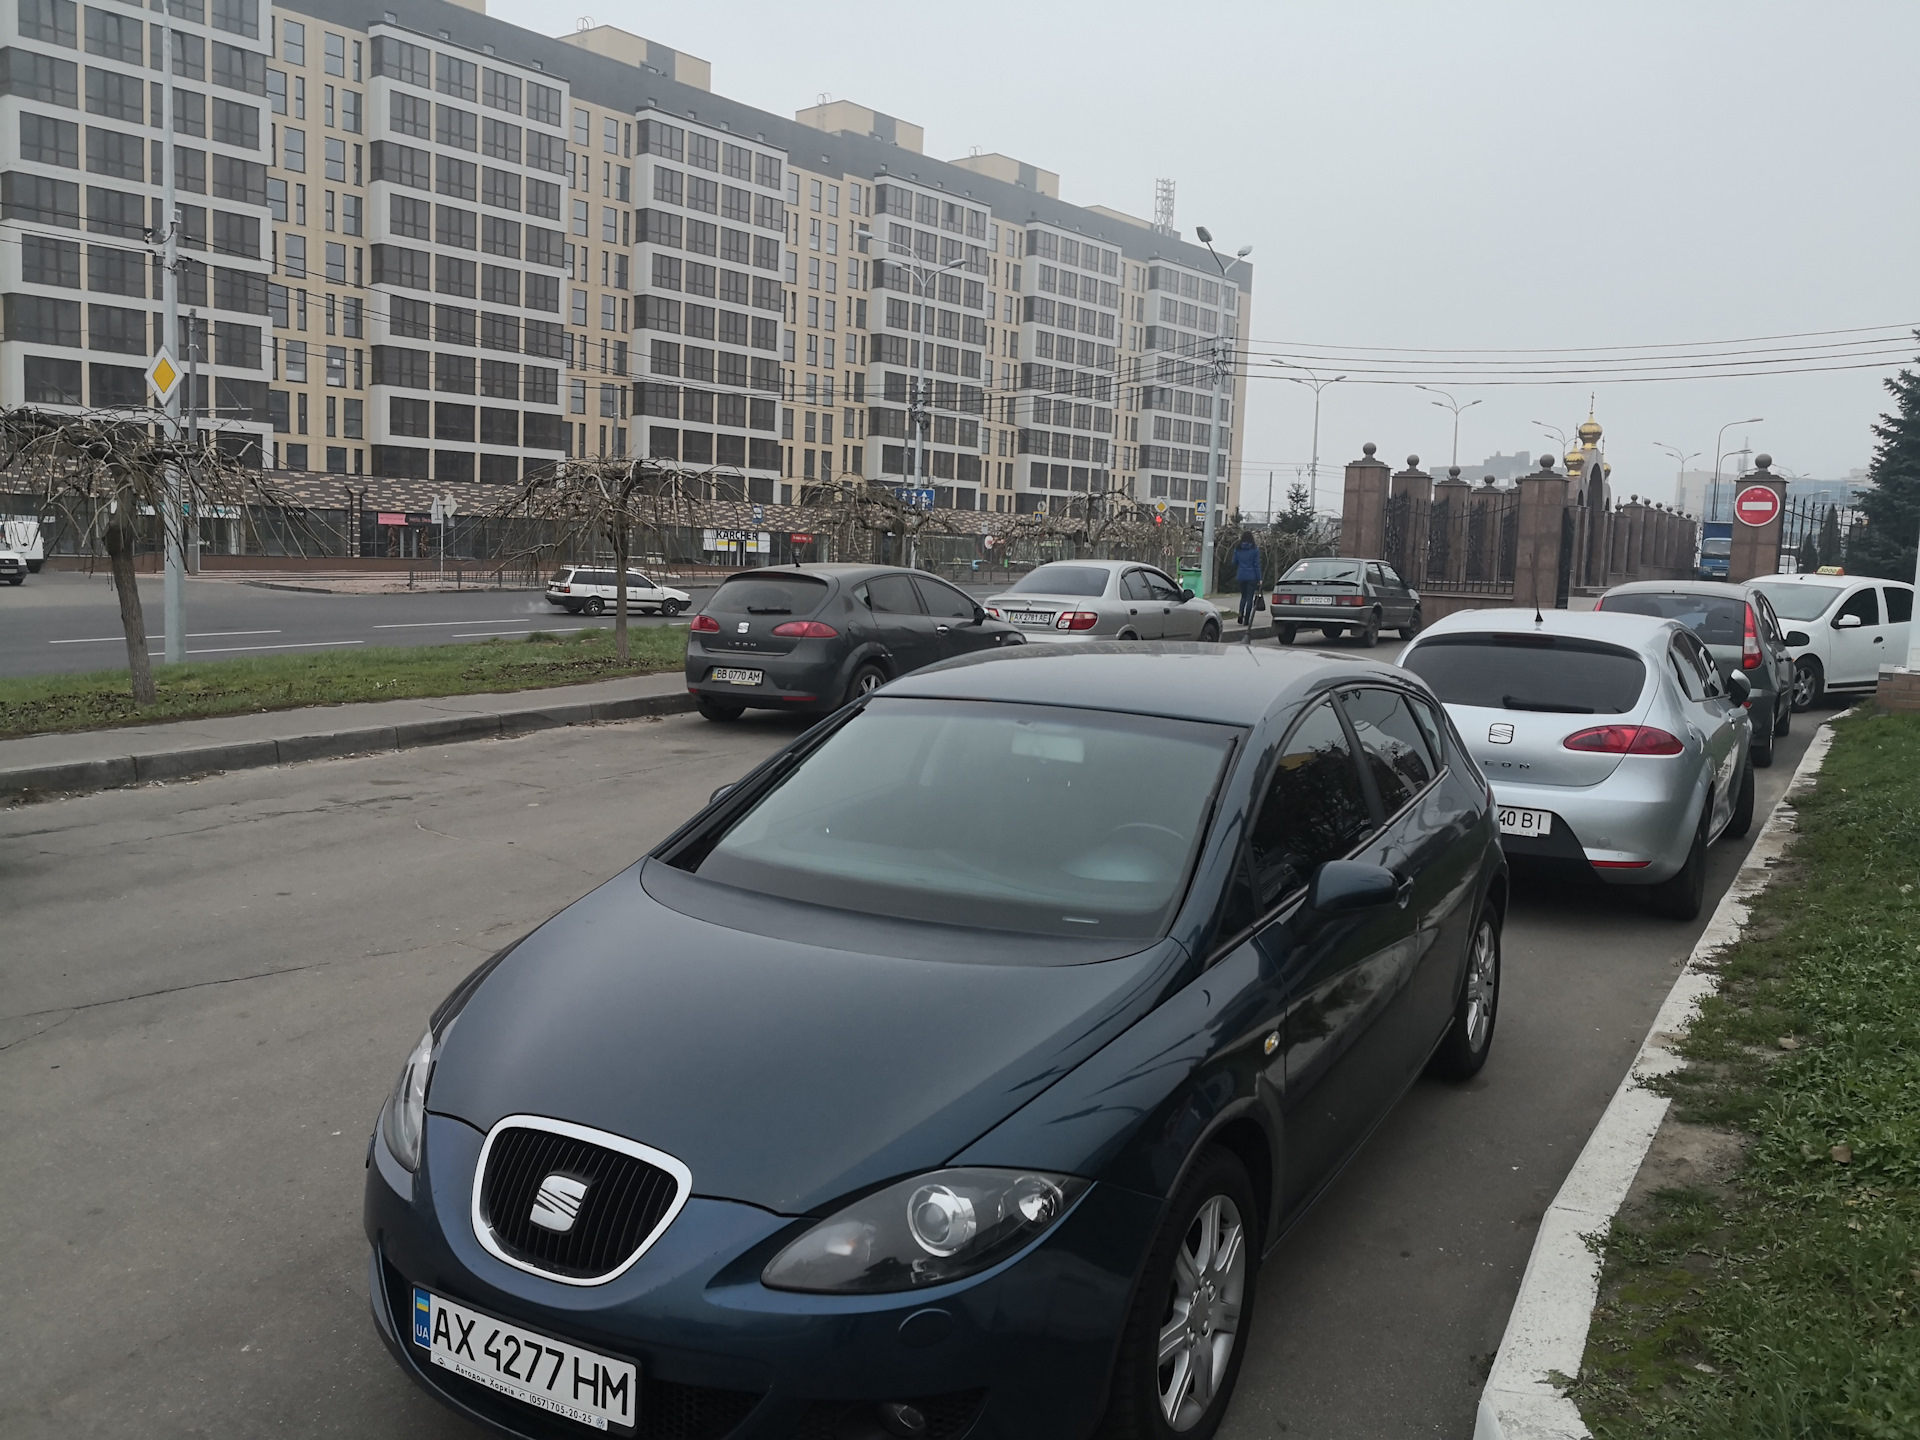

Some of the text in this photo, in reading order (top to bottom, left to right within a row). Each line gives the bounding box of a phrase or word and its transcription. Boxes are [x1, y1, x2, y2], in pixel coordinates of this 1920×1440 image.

[717, 669, 760, 681] BB 0770 AM
[1484, 759, 1530, 769] EON
[1499, 810, 1542, 830] 40 BI
[416, 1324, 429, 1340] UA
[433, 1307, 628, 1416] AX 4277 HM
[455, 1364, 486, 1383] Автодом
[489, 1378, 515, 1395] Харків
